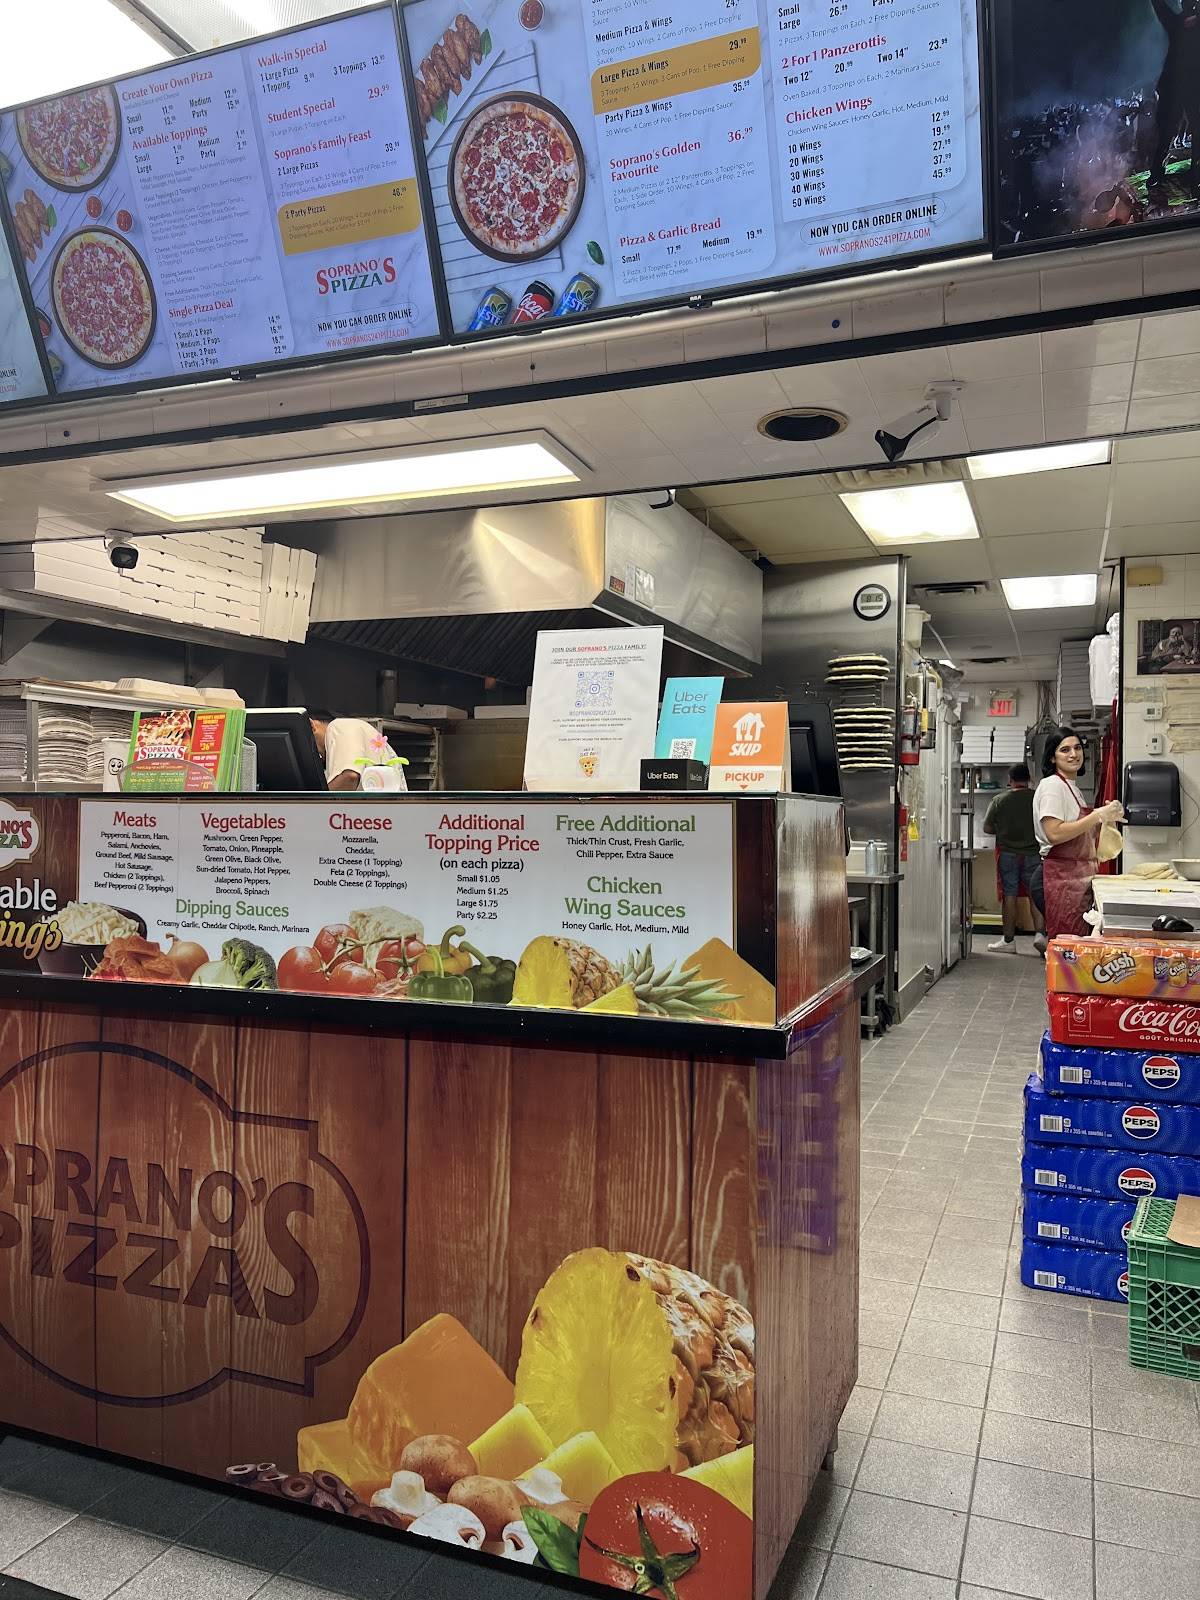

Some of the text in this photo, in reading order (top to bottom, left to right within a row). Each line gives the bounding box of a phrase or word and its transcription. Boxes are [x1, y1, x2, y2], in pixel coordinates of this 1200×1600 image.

[778, 4, 800, 17] Small
[779, 5, 848, 30] Large 26.99
[596, 16, 672, 42] Medium Pizza & Wings
[729, 37, 747, 50] 29.99
[782, 35, 887, 68] 2 For 1 Panzerottis
[258, 41, 327, 67] Walk-in Special
[784, 75, 798, 85] Two
[835, 61, 853, 73] 20.99
[878, 53, 892, 63] Two
[928, 38, 948, 52] 23.99
[600, 59, 669, 84] Large Pizza & Wings
[122, 71, 213, 101] Create Your Own Pizza
[368, 84, 389, 99] 29.99
[733, 80, 750, 92] 35.99
[268, 98, 335, 123] Student Special
[605, 101, 672, 123] Party Pizza & Wings
[786, 96, 872, 124] Chicken Wings
[132, 126, 208, 150] Available Toppings
[728, 127, 753, 142] 36.99
[789, 111, 949, 154] 10 Wings 12.99
[274, 130, 371, 161] Soprano's Family Feast
[789, 125, 950, 167] 20 Wings 19.99
[610, 141, 701, 170] Soprano's Golden
[790, 139, 951, 180] 30 Wings 27.99
[278, 168, 282, 176] 2
[283, 164, 300, 175] Large
[301, 161, 318, 171] Pizzas
[612, 165, 659, 182] Favourite
[792, 153, 951, 194] 40 Wings 37.99
[792, 167, 951, 207] 50 Wings 45.99
[290, 207, 306, 218] Party
[307, 205, 326, 215] Pizzas
[810, 205, 937, 238] NOW YOU CAN ORDER ONLINE
[620, 218, 721, 247] Pizza & Garlic Bread
[622, 229, 762, 264] Small 17.99 Medium 19.99
[818, 228, 930, 257] WWW.SOPRANOS241PIZZA.COM
[316, 257, 396, 295] SOPRANO'S
[169, 299, 233, 319] Single Pizza Deal
[318, 309, 412, 331] NOW YOU CAN ORDER ONLINE
[675, 692, 708, 702] Uber
[672, 704, 706, 714] Eats
[729, 743, 762, 756] SKIP
[725, 773, 764, 781] PICKUP
[113, 812, 157, 827] Meats
[201, 813, 286, 832] Vegetables
[329, 814, 392, 830] Cheese
[439, 815, 525, 830] Additional
[556, 815, 695, 832] Free Additional
[425, 835, 540, 854] Topping Price
[566, 838, 684, 847] Thick/Thin Crust, Fresh Garlic,
[576, 850, 593, 858] Chili
[595, 851, 624, 859] Pepper,
[440, 858, 524, 872] (on each pizza)
[457, 875, 499, 883] Small $1.05
[587, 876, 662, 894] Chicken
[457, 888, 508, 896] Medium $1.25
[176, 899, 289, 919] Dipping Sauces
[457, 900, 498, 908] Large $1.75
[565, 898, 685, 919] Wing Sauces
[457, 912, 497, 920] Party $2.25
[562, 922, 688, 934] Honey Garlic, Hot, Medium, Mild
[1093, 952, 1135, 983] Crush
[1145, 1067, 1178, 1077] PEPSI
[1125, 1118, 1158, 1127] PEPSI
[1121, 1179, 1154, 1189] PEPSI
